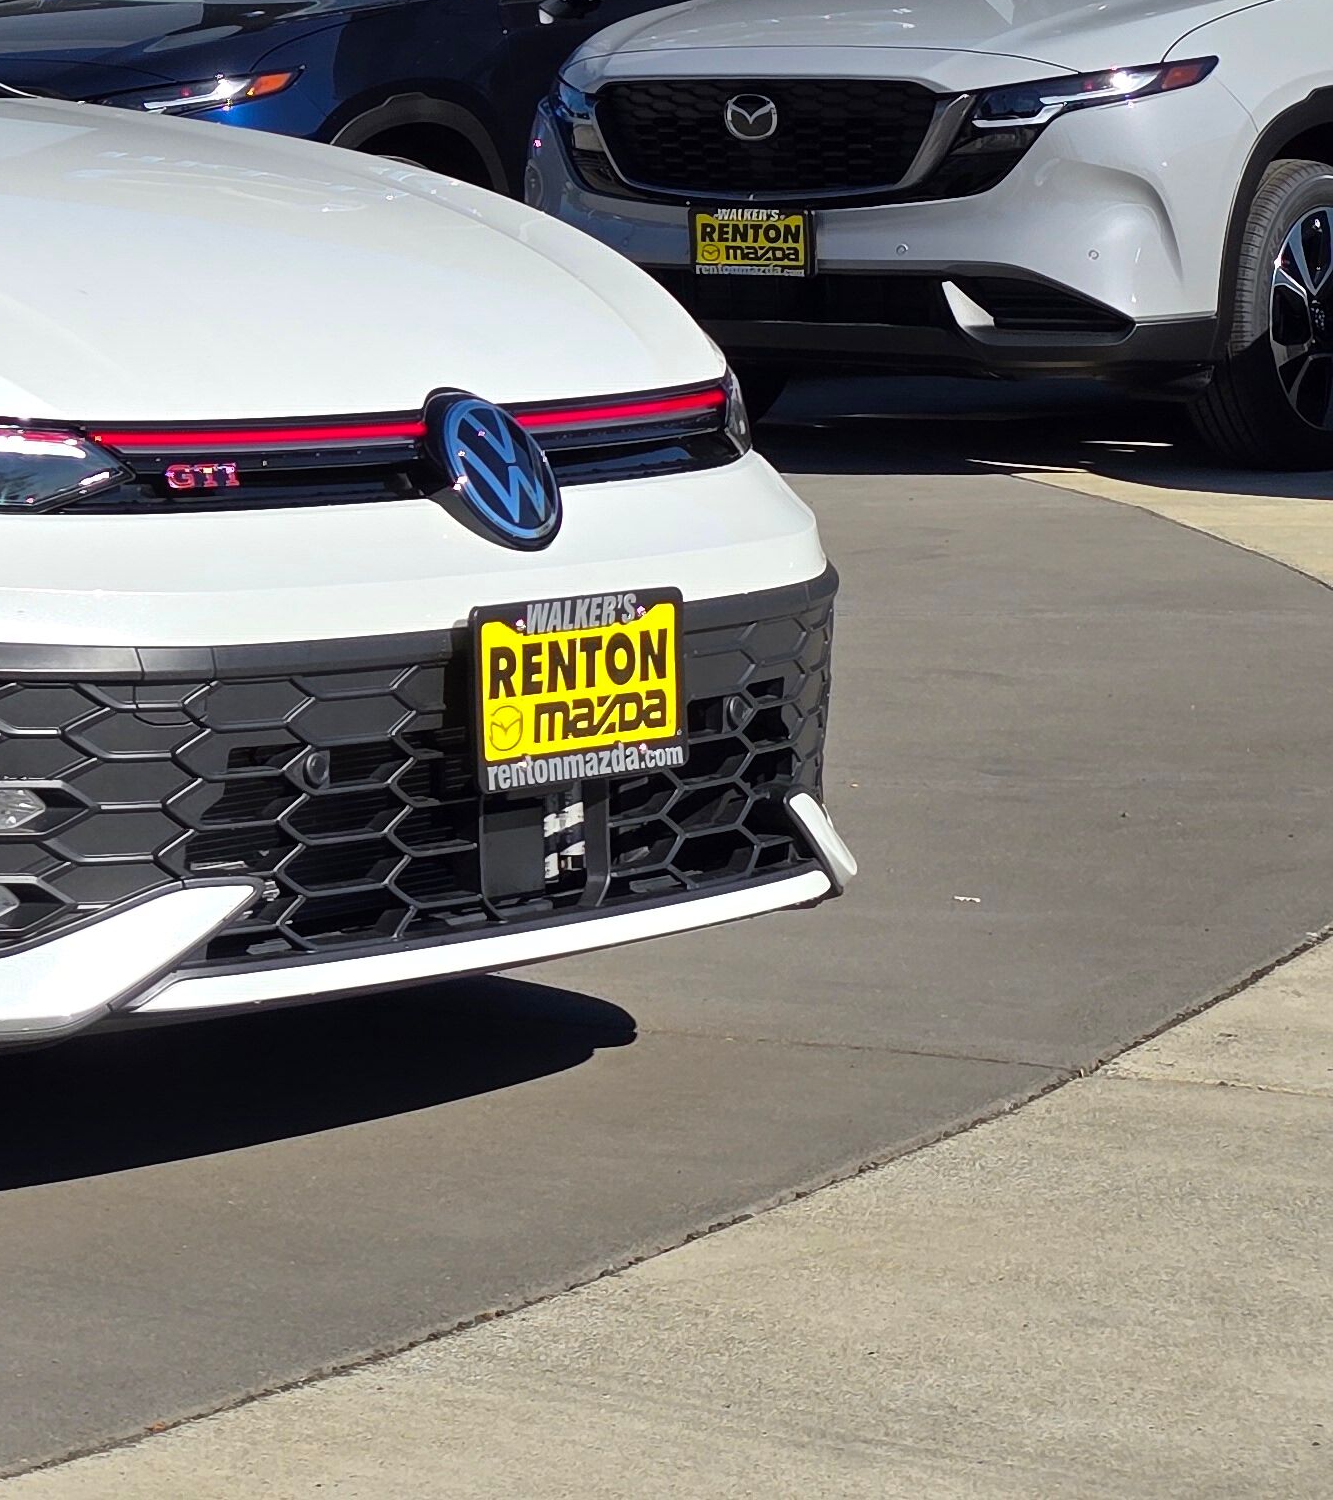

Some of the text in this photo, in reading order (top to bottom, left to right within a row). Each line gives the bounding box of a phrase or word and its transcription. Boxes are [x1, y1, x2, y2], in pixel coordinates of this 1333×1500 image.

[718, 208, 780, 221] WALKER'S
[701, 223, 800, 244] RENTON
[165, 463, 240, 489] GTI
[526, 593, 637, 635] WALKER'S
[489, 628, 668, 700] RENTON
[487, 743, 683, 791] rentonmazda.com
